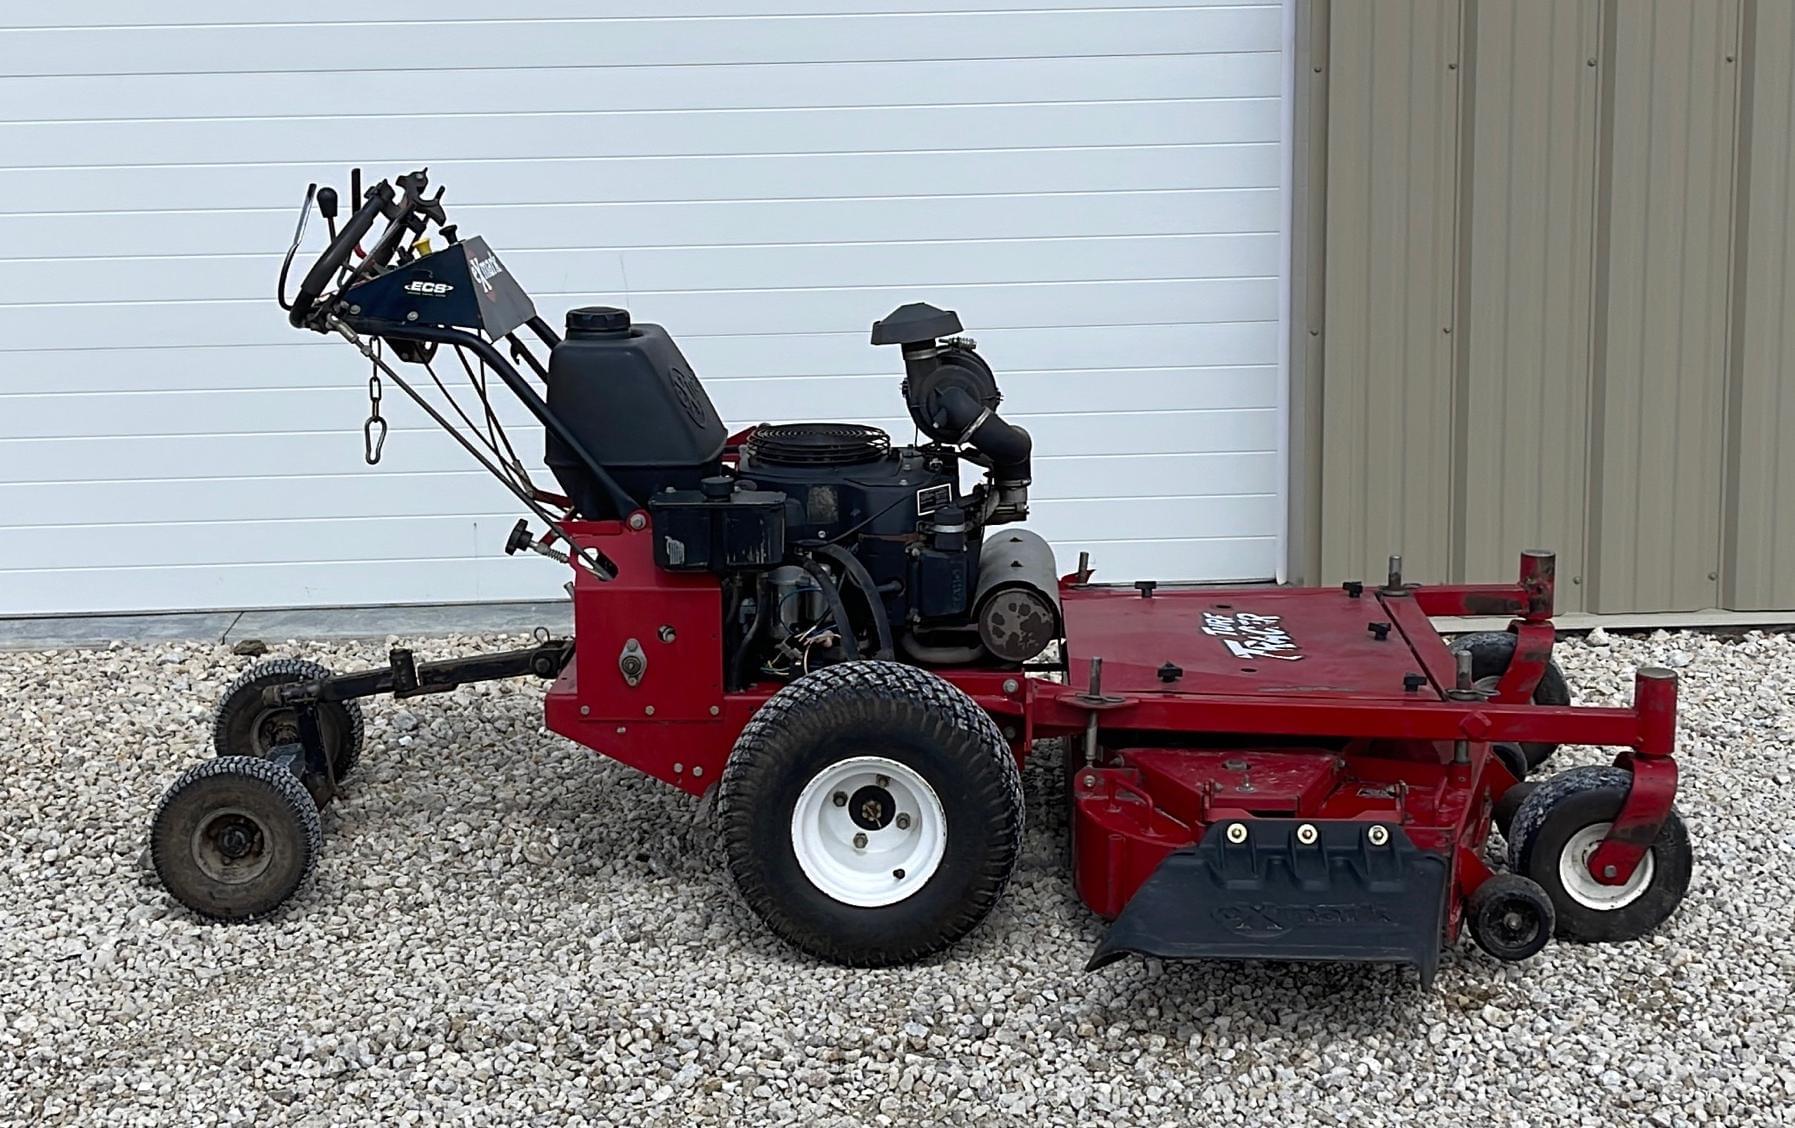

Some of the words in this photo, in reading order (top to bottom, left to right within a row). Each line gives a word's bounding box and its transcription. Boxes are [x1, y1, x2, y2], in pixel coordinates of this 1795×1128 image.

[410, 281, 447, 293] ECS
[1201, 612, 1238, 636] TURF
[1223, 613, 1303, 660] TRACER
